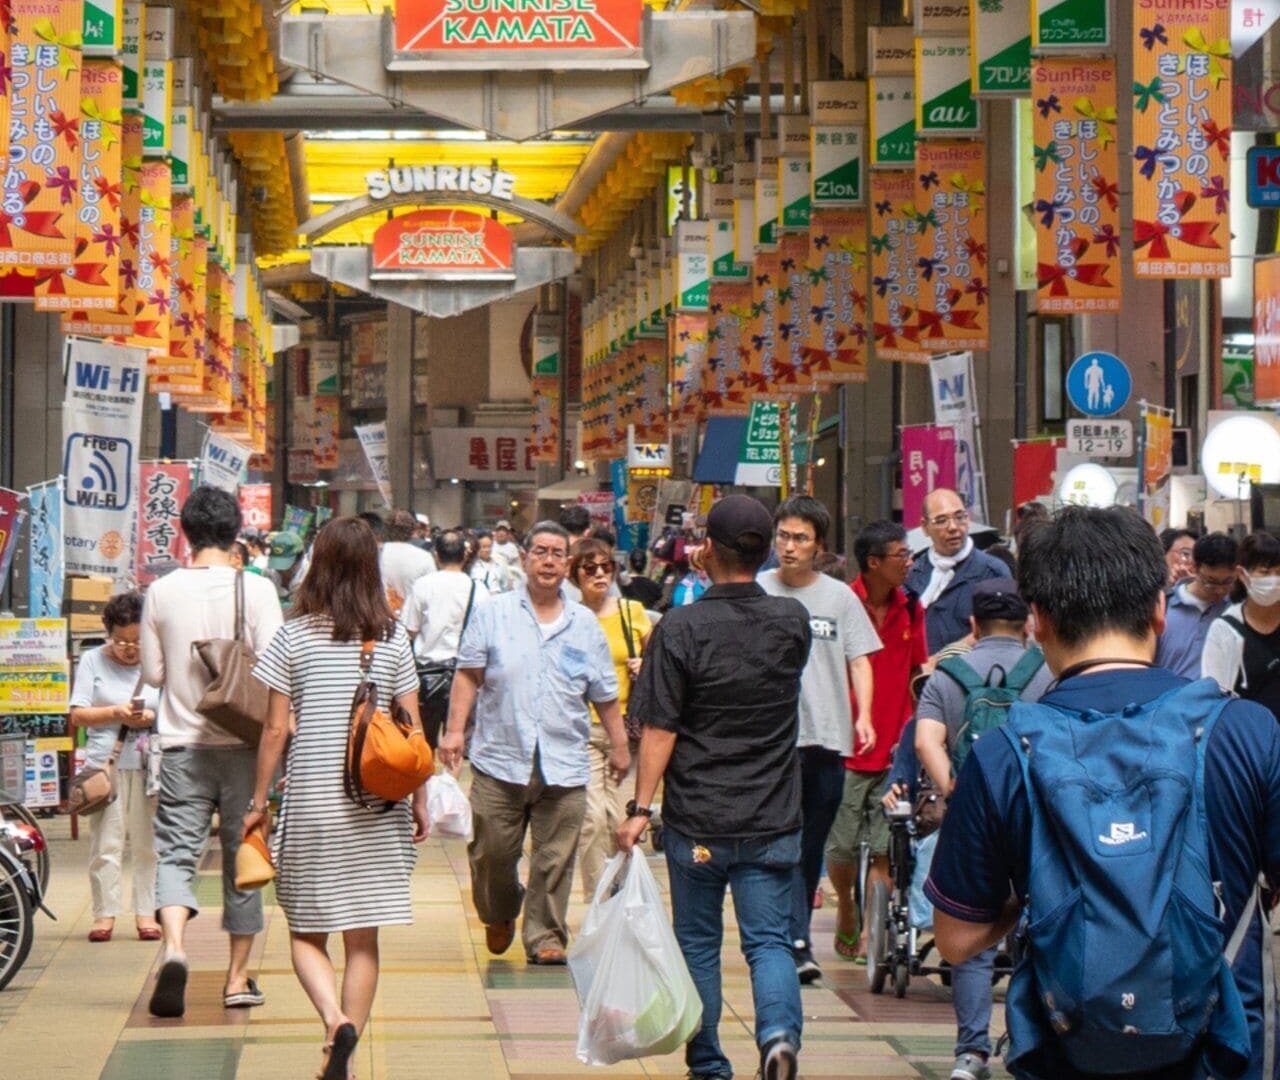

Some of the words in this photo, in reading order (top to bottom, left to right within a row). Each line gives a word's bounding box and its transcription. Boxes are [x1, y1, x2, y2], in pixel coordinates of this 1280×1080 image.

[442, 15, 596, 44] KAMATA
[1035, 67, 1113, 84] SunRise
[1157, 52, 1182, 239] きっとみつかる。
[366, 165, 516, 201] SUNRISE
[399, 232, 486, 249] SUNRISE
[399, 248, 485, 265] KAMATA
[82, 435, 118, 453] Free
[75, 490, 118, 509] Wi-Fi
